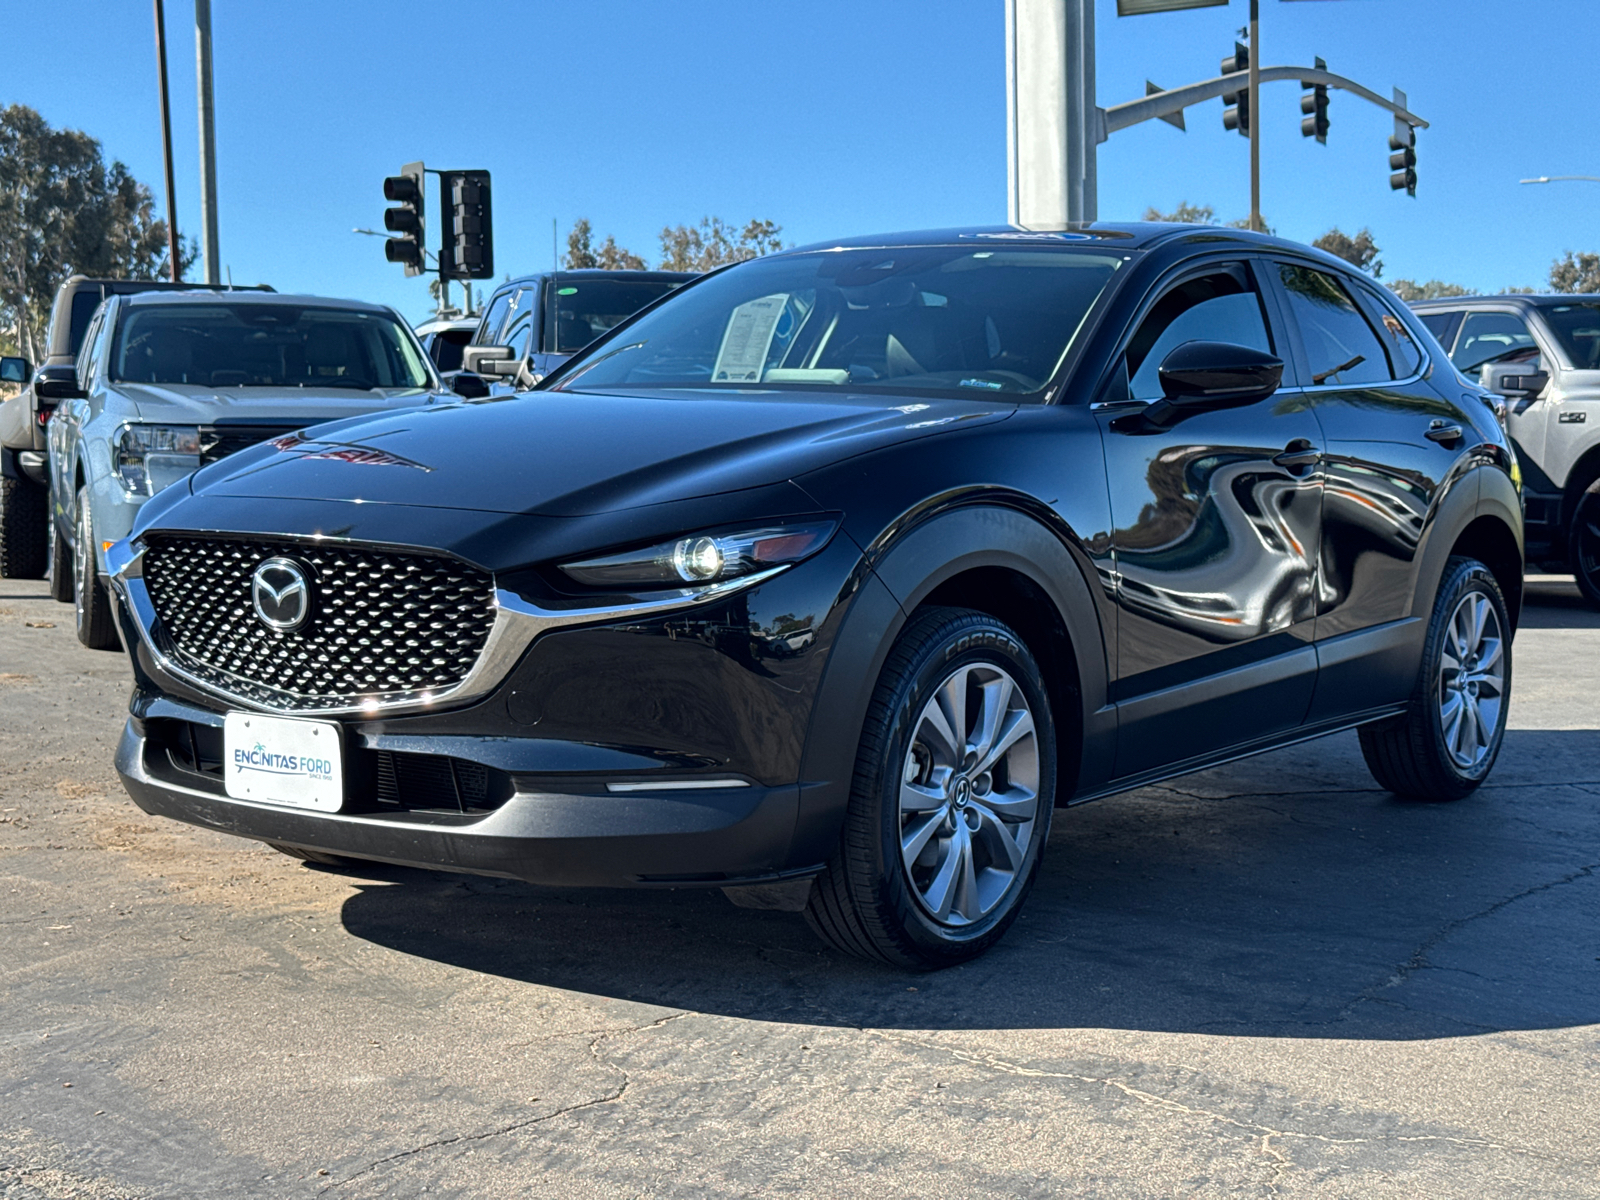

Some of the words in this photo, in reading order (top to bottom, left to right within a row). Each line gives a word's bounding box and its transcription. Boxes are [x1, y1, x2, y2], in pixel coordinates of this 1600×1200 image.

[945, 632, 1020, 661] COOPER
[234, 749, 298, 770] ENCINITAS
[300, 757, 331, 774] FORD
